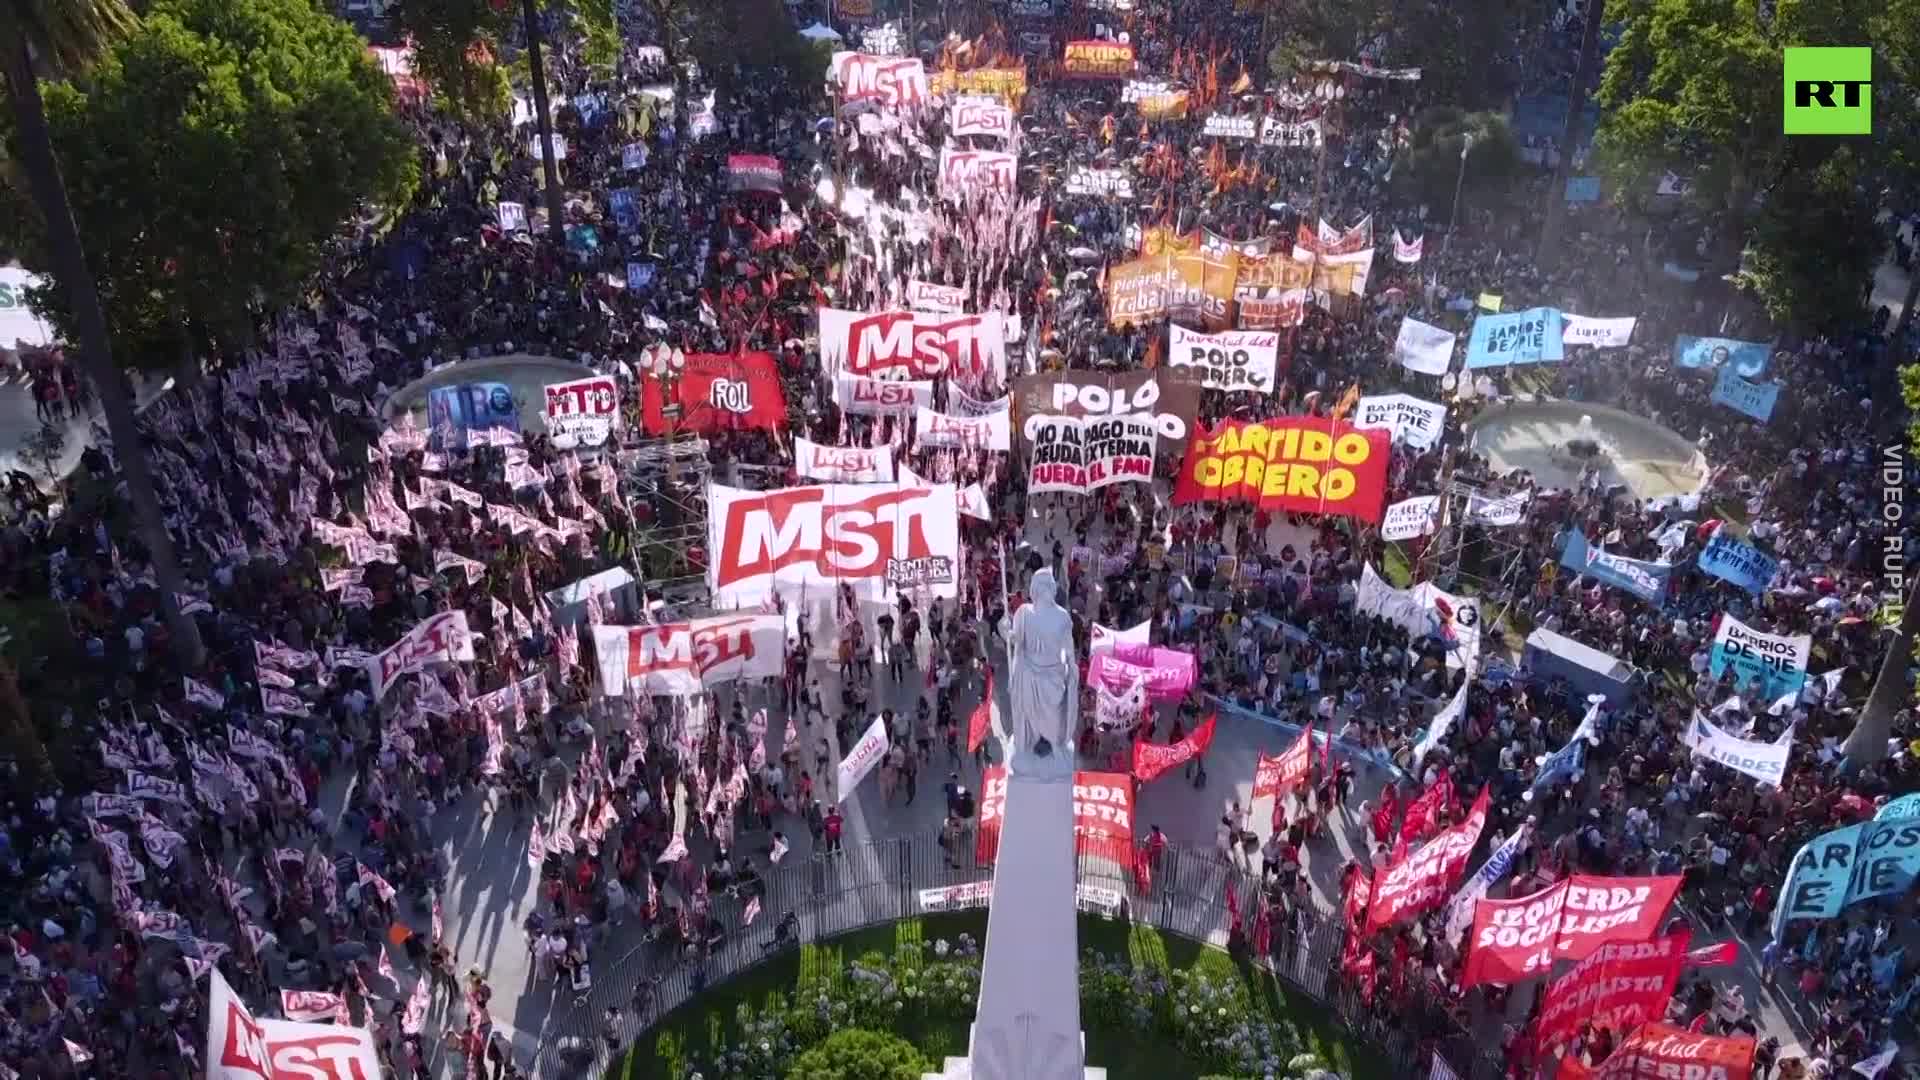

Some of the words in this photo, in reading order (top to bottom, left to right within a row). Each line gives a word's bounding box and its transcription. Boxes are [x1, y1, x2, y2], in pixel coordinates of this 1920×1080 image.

[1065, 45, 1132, 61] PARTIDO
[847, 60, 928, 109] MST
[961, 107, 1006, 128] MST
[951, 158, 1011, 188] MST
[921, 287, 963, 304] MST
[856, 318, 990, 374] MST
[1175, 331, 1244, 347] Juventud
[1248, 335, 1276, 347] del
[1487, 339, 1509, 353] DE
[1518, 333, 1544, 349] PIE
[1191, 347, 1249, 369] POLO
[547, 381, 616, 416] MTD
[712, 378, 752, 411] FOL
[856, 380, 915, 405] MST
[1053, 379, 1160, 415] POLO
[1365, 414, 1385, 425] DE
[1398, 413, 1431, 431] PIE
[1367, 403, 1432, 418] BARRIOS
[1036, 424, 1056, 445] NO
[1062, 425, 1081, 446] AL
[1084, 420, 1124, 446] PAGO
[1127, 423, 1140, 435] DE
[1141, 425, 1153, 437] LA
[816, 449, 877, 471] MST
[1034, 446, 1082, 467] DEUDA
[1085, 439, 1152, 466] EXTERNA
[1032, 464, 1087, 487] FUERA
[1090, 460, 1106, 482] EL
[1112, 457, 1152, 476] FMI
[1194, 455, 1356, 500] OBRERO
[736, 499, 942, 570] MST
[1598, 551, 1659, 591] LIBRES
[640, 622, 750, 669] MST
[1728, 625, 1797, 658] BARRIOS
[1723, 639, 1755, 660] DE
[1762, 652, 1796, 675] PIE
[1710, 746, 1782, 773] LIBRES
[1491, 885, 1651, 926] IZQUIERDA
[1478, 905, 1642, 948] SOCIALISTA
[235, 1012, 371, 1080] MST
